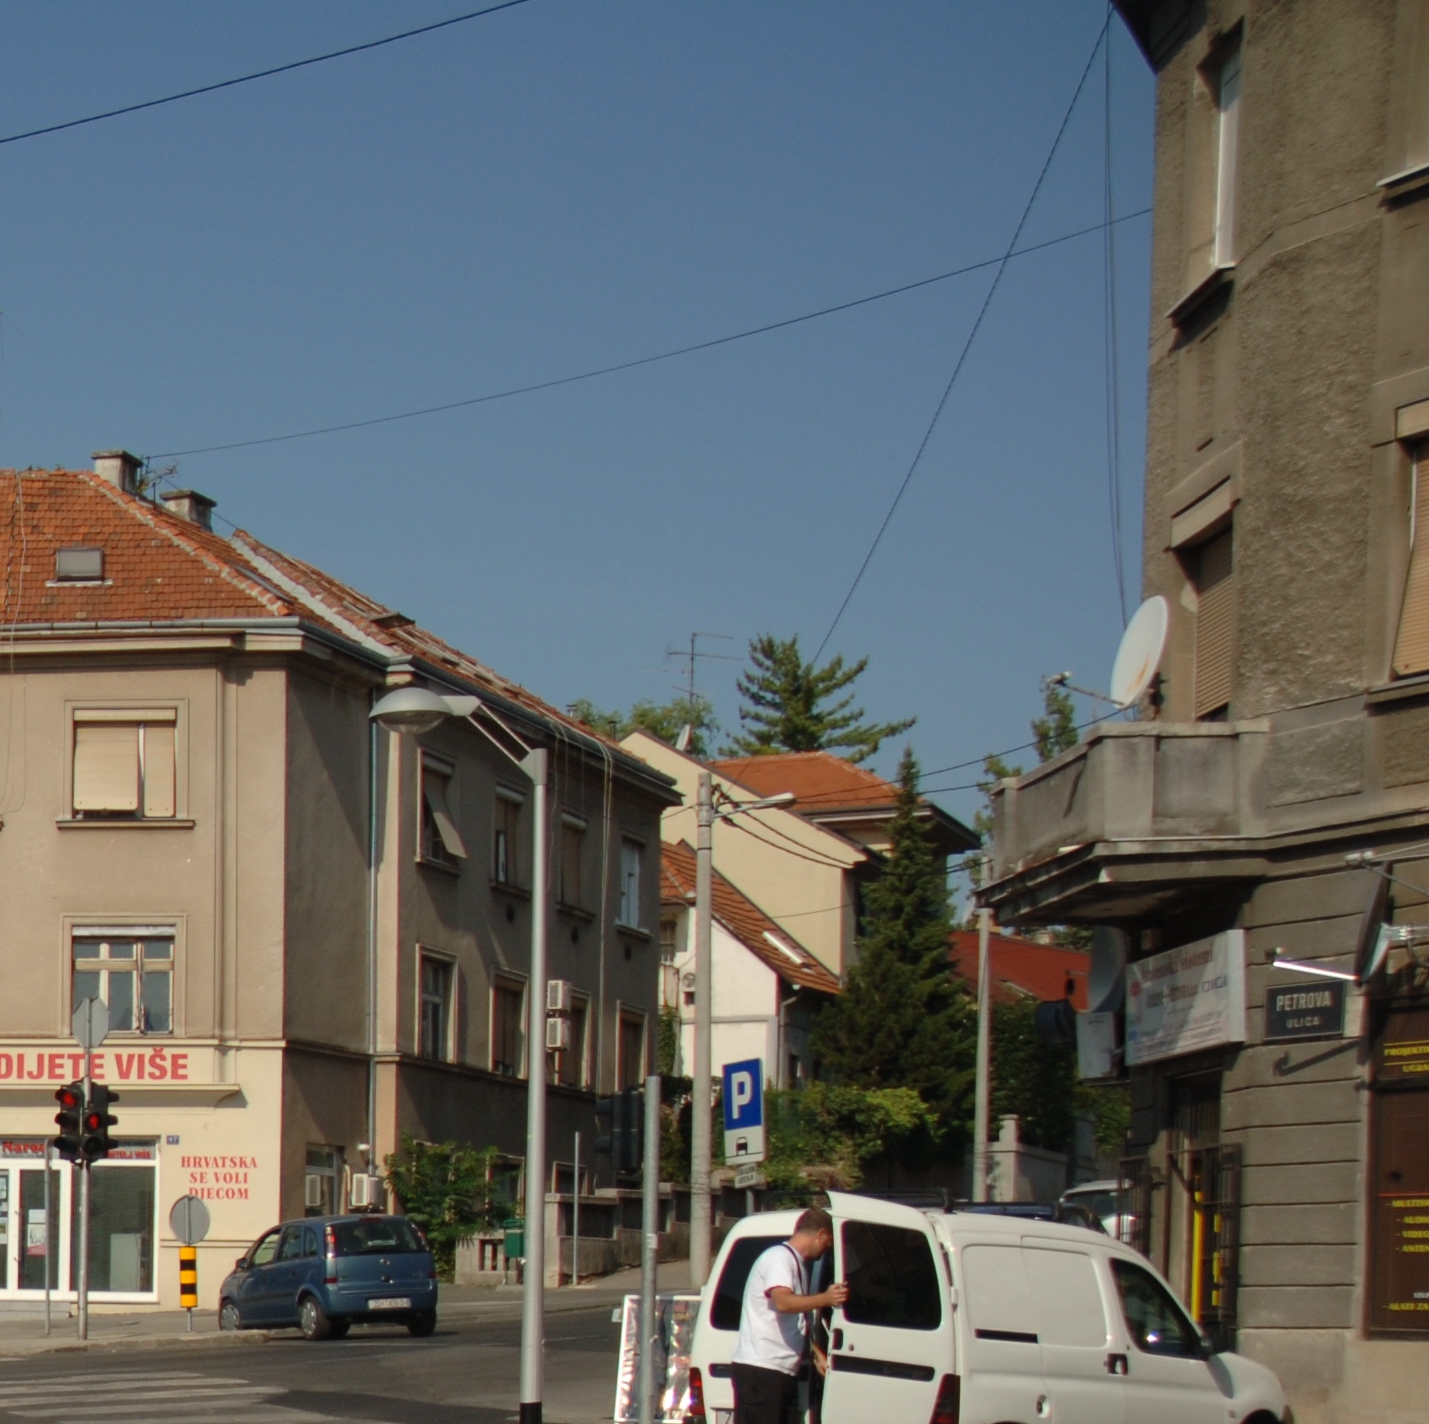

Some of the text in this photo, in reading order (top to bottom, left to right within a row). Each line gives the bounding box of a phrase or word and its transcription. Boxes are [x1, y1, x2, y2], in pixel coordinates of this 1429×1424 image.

[1276, 991, 1331, 1012] PETROVA
[1286, 1016, 1319, 1028] ULICA
[114, 1048, 188, 1080] VIŠE
[731, 1071, 752, 1119] P
[181, 1156, 258, 1168] HRVATSKA
[190, 1172, 248, 1184] SE VOLI
[189, 1187, 249, 1199] DJECOM
